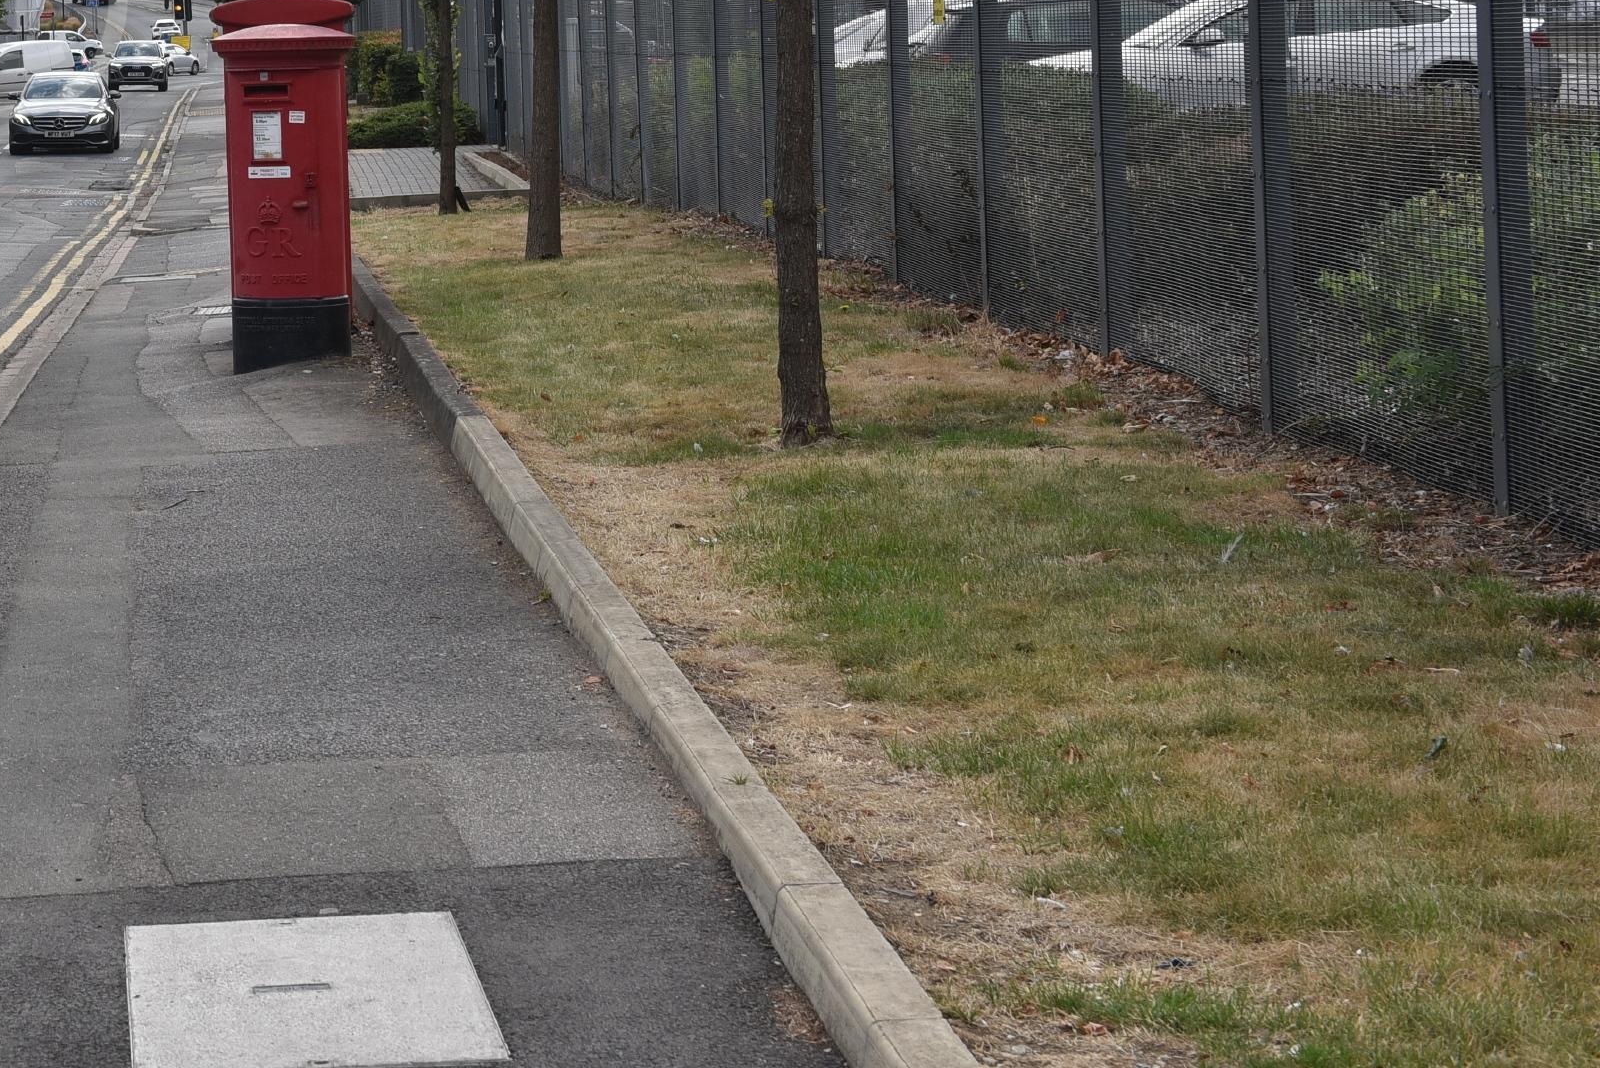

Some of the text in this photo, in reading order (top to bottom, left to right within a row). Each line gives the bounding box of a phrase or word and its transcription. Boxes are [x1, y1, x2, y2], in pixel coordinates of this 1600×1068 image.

[246, 226, 303, 258] GR
[240, 272, 308, 285] POST OFFICE
